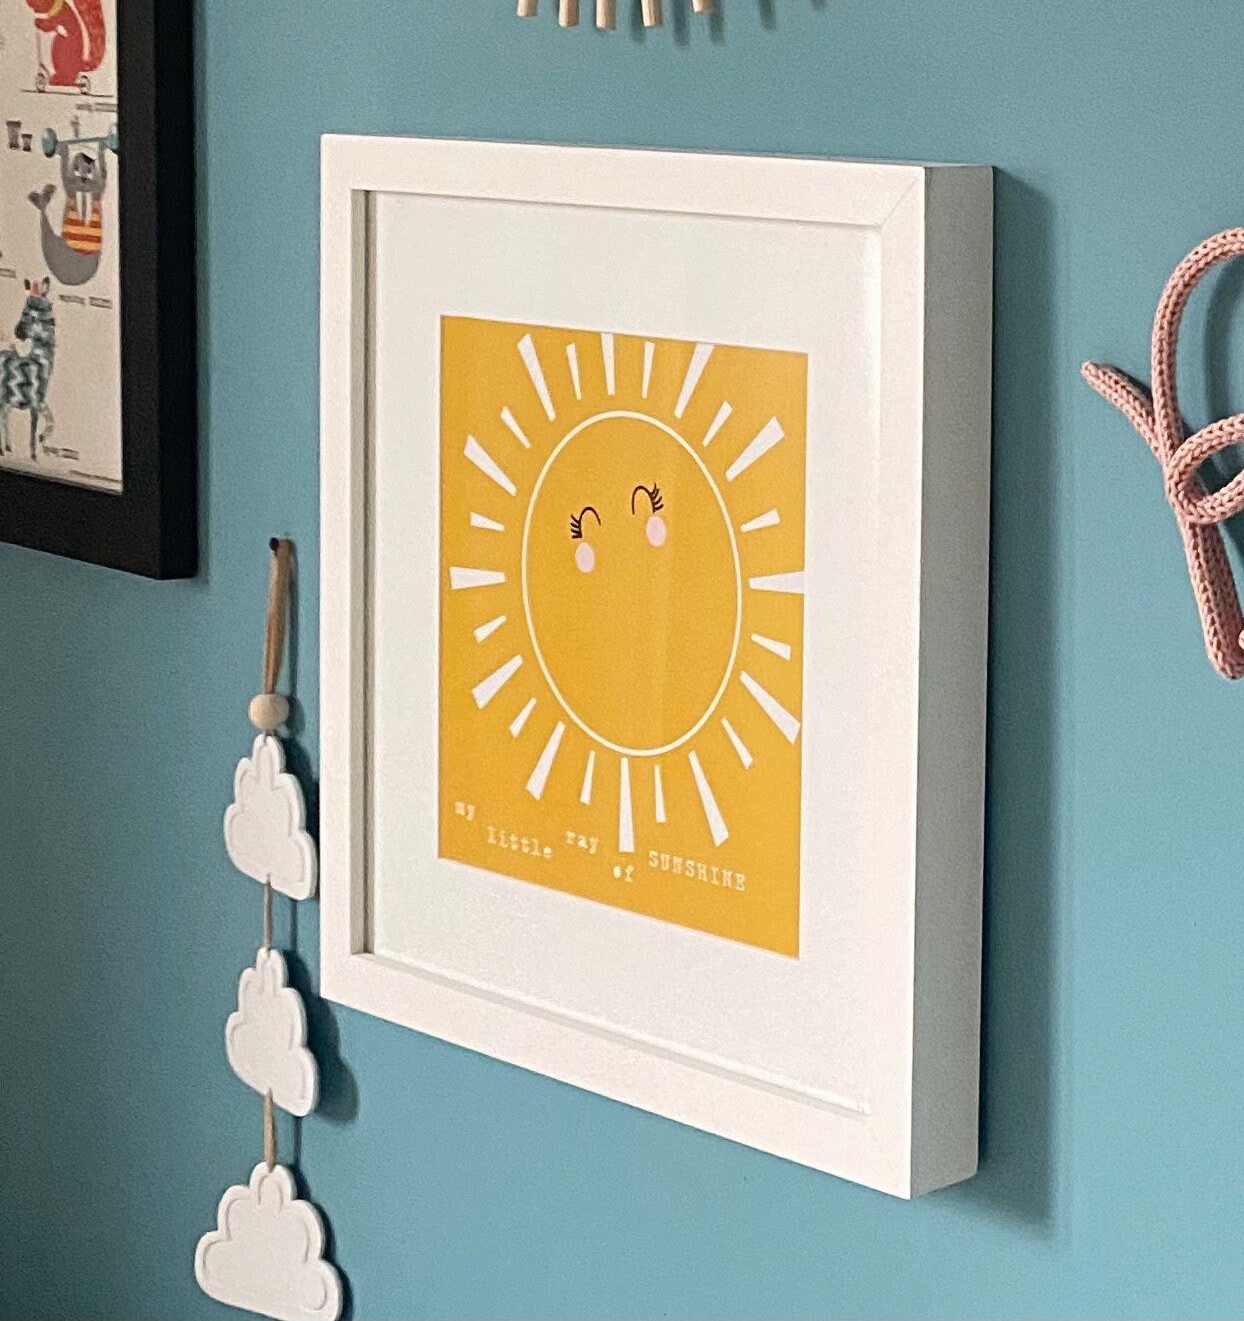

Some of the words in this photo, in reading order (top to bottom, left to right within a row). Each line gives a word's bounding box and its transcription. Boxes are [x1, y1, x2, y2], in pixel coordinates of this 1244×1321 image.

[454, 801, 476, 821] my
[486, 826, 554, 859] little
[565, 830, 600, 855] ray
[612, 864, 635, 883] of
[648, 850, 747, 892] SUNSHINE
